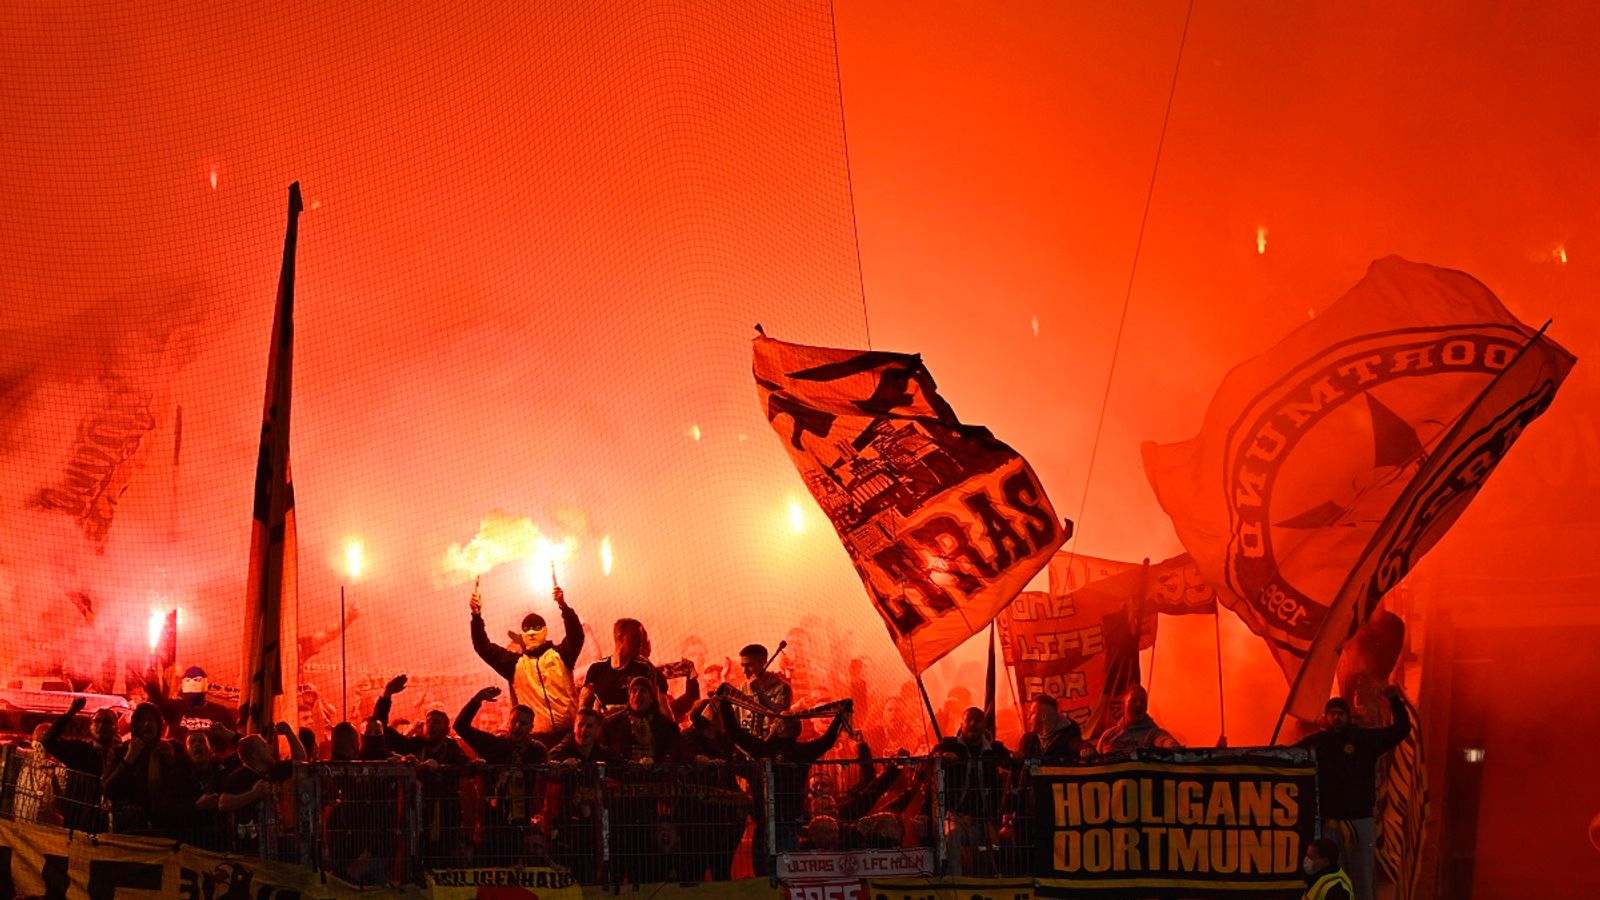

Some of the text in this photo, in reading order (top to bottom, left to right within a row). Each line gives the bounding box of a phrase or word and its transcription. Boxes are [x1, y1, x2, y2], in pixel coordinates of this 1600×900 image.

[1011, 591, 1076, 622] ONE
[1018, 623, 1105, 662] LIFE
[1023, 671, 1088, 702] FOR
[1052, 778, 1299, 827] HOOLIGANS
[1053, 827, 1300, 874] DORTMUND
